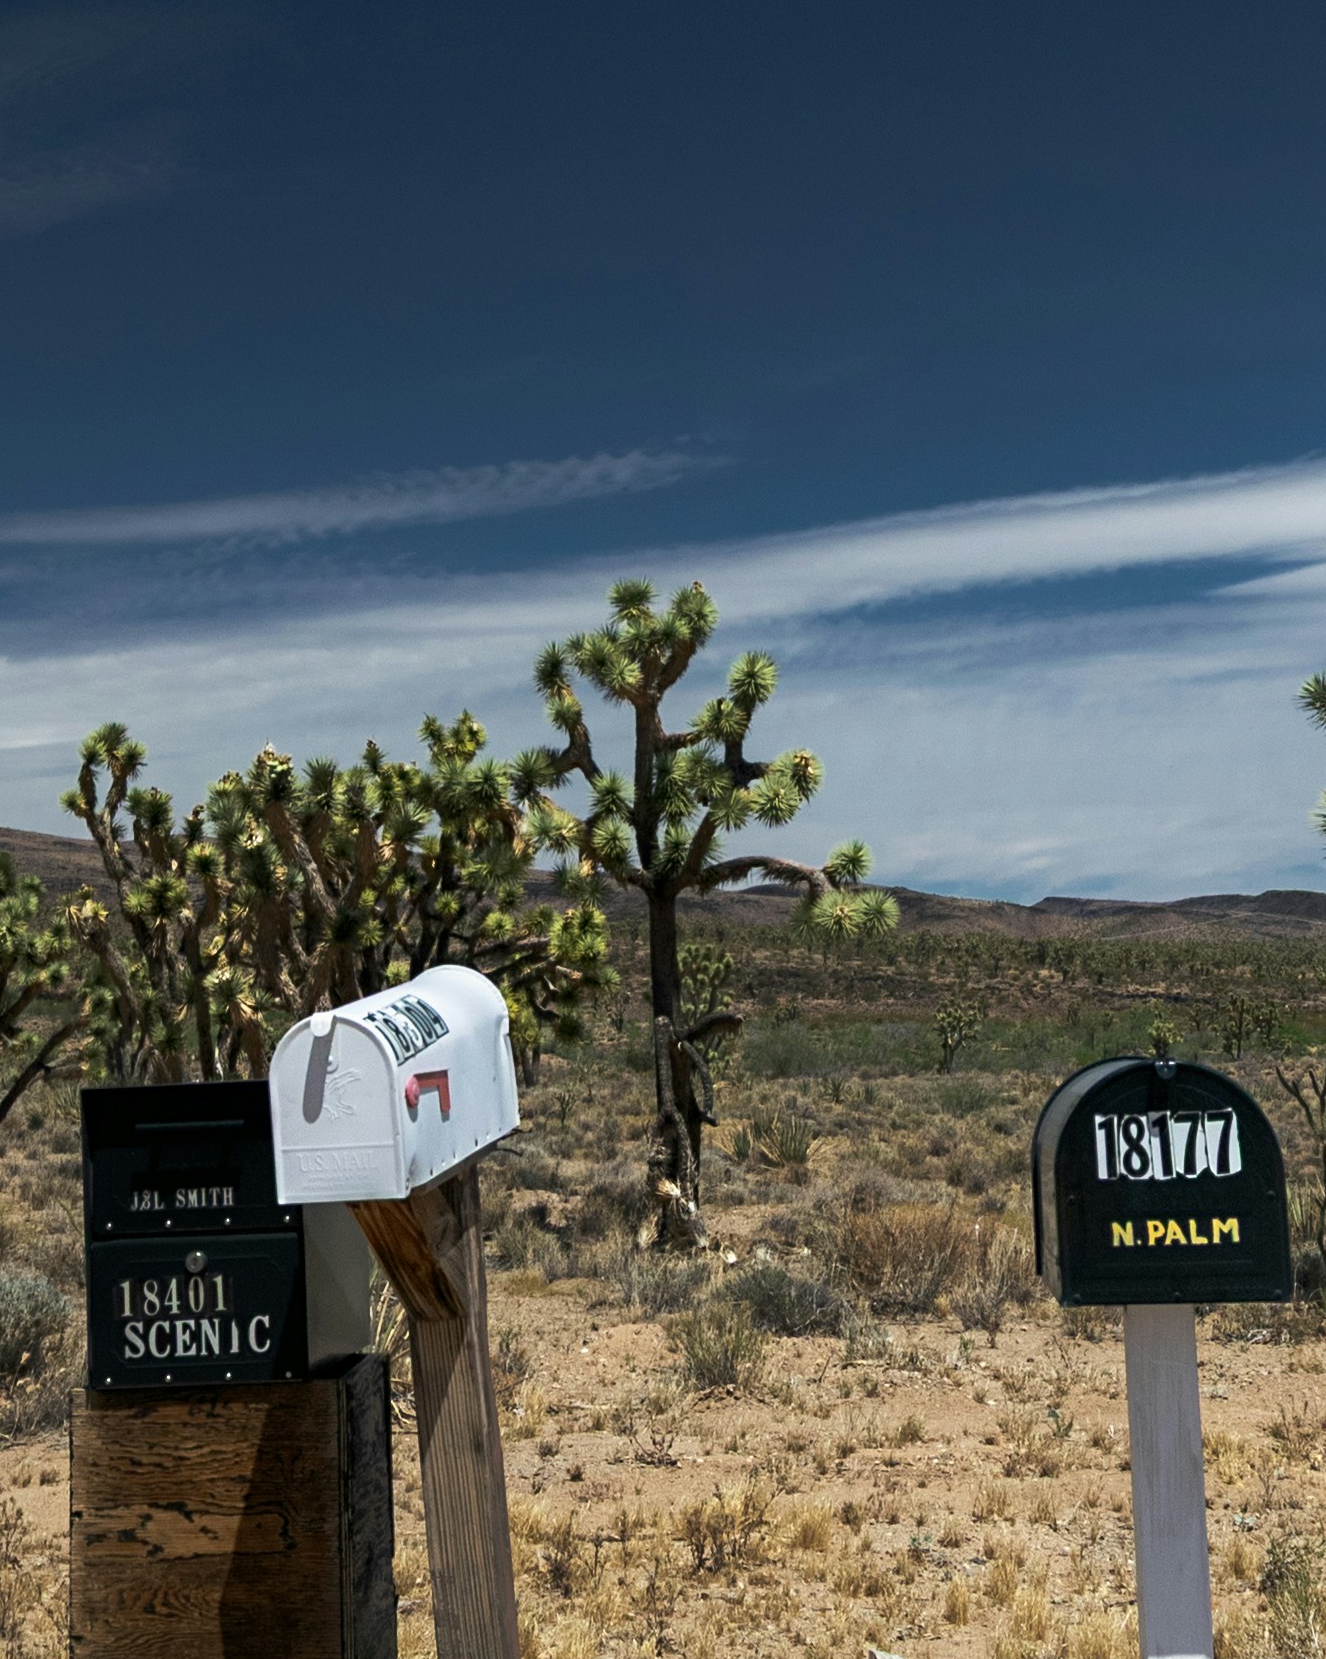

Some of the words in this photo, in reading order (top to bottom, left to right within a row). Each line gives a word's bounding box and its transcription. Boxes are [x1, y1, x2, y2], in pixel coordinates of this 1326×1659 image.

[332, 1150, 378, 1171] MAIL
[1097, 1111, 1235, 1178] 18177
[175, 1186, 234, 1209] SMITH
[119, 1274, 228, 1318] 18401
[123, 1315, 272, 1360] SCENIC
